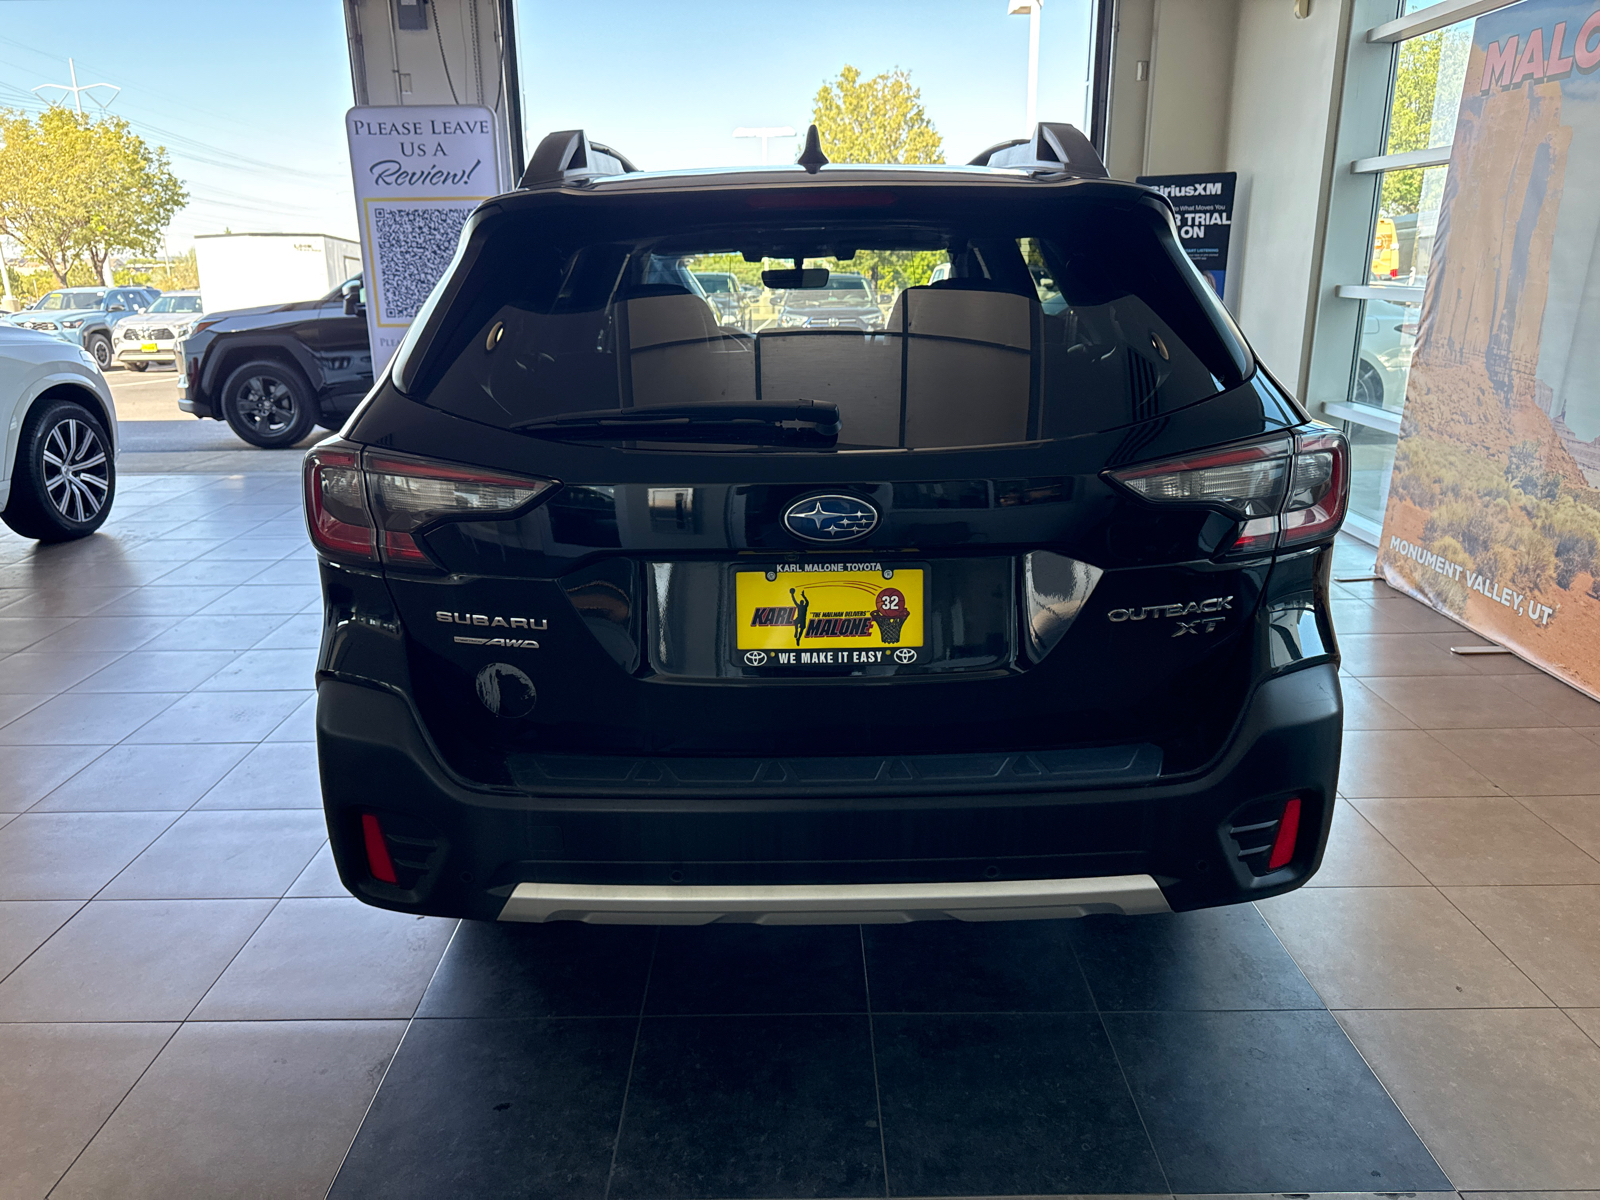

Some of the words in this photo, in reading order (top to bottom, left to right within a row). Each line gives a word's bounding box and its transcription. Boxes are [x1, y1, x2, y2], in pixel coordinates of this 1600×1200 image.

[353, 120, 423, 136] PLEASE
[430, 119, 490, 135] LEAVE
[400, 141, 427, 158] US
[432, 141, 448, 157] A
[369, 158, 482, 186] Review!
[1184, 212, 1232, 226] TRIAL
[1180, 225, 1205, 239] ON
[776, 563, 802, 572] KARL
[804, 563, 845, 572] MALONE
[845, 562, 882, 571] TOYOTA
[1389, 535, 1463, 581] MONUMENT
[1466, 570, 1524, 616] VALLEY,
[1527, 600, 1553, 625] UT
[881, 595, 899, 610] 32
[1108, 596, 1233, 622] OUTBACK
[436, 611, 547, 630] SUBARU
[751, 606, 796, 627] KARL
[804, 617, 874, 639] MALONE
[1171, 616, 1226, 638] XT
[485, 638, 540, 649] AWD
[778, 652, 797, 664] WE
[801, 651, 834, 664] MAKE
[838, 651, 849, 663] IT
[853, 651, 883, 663] EASY
